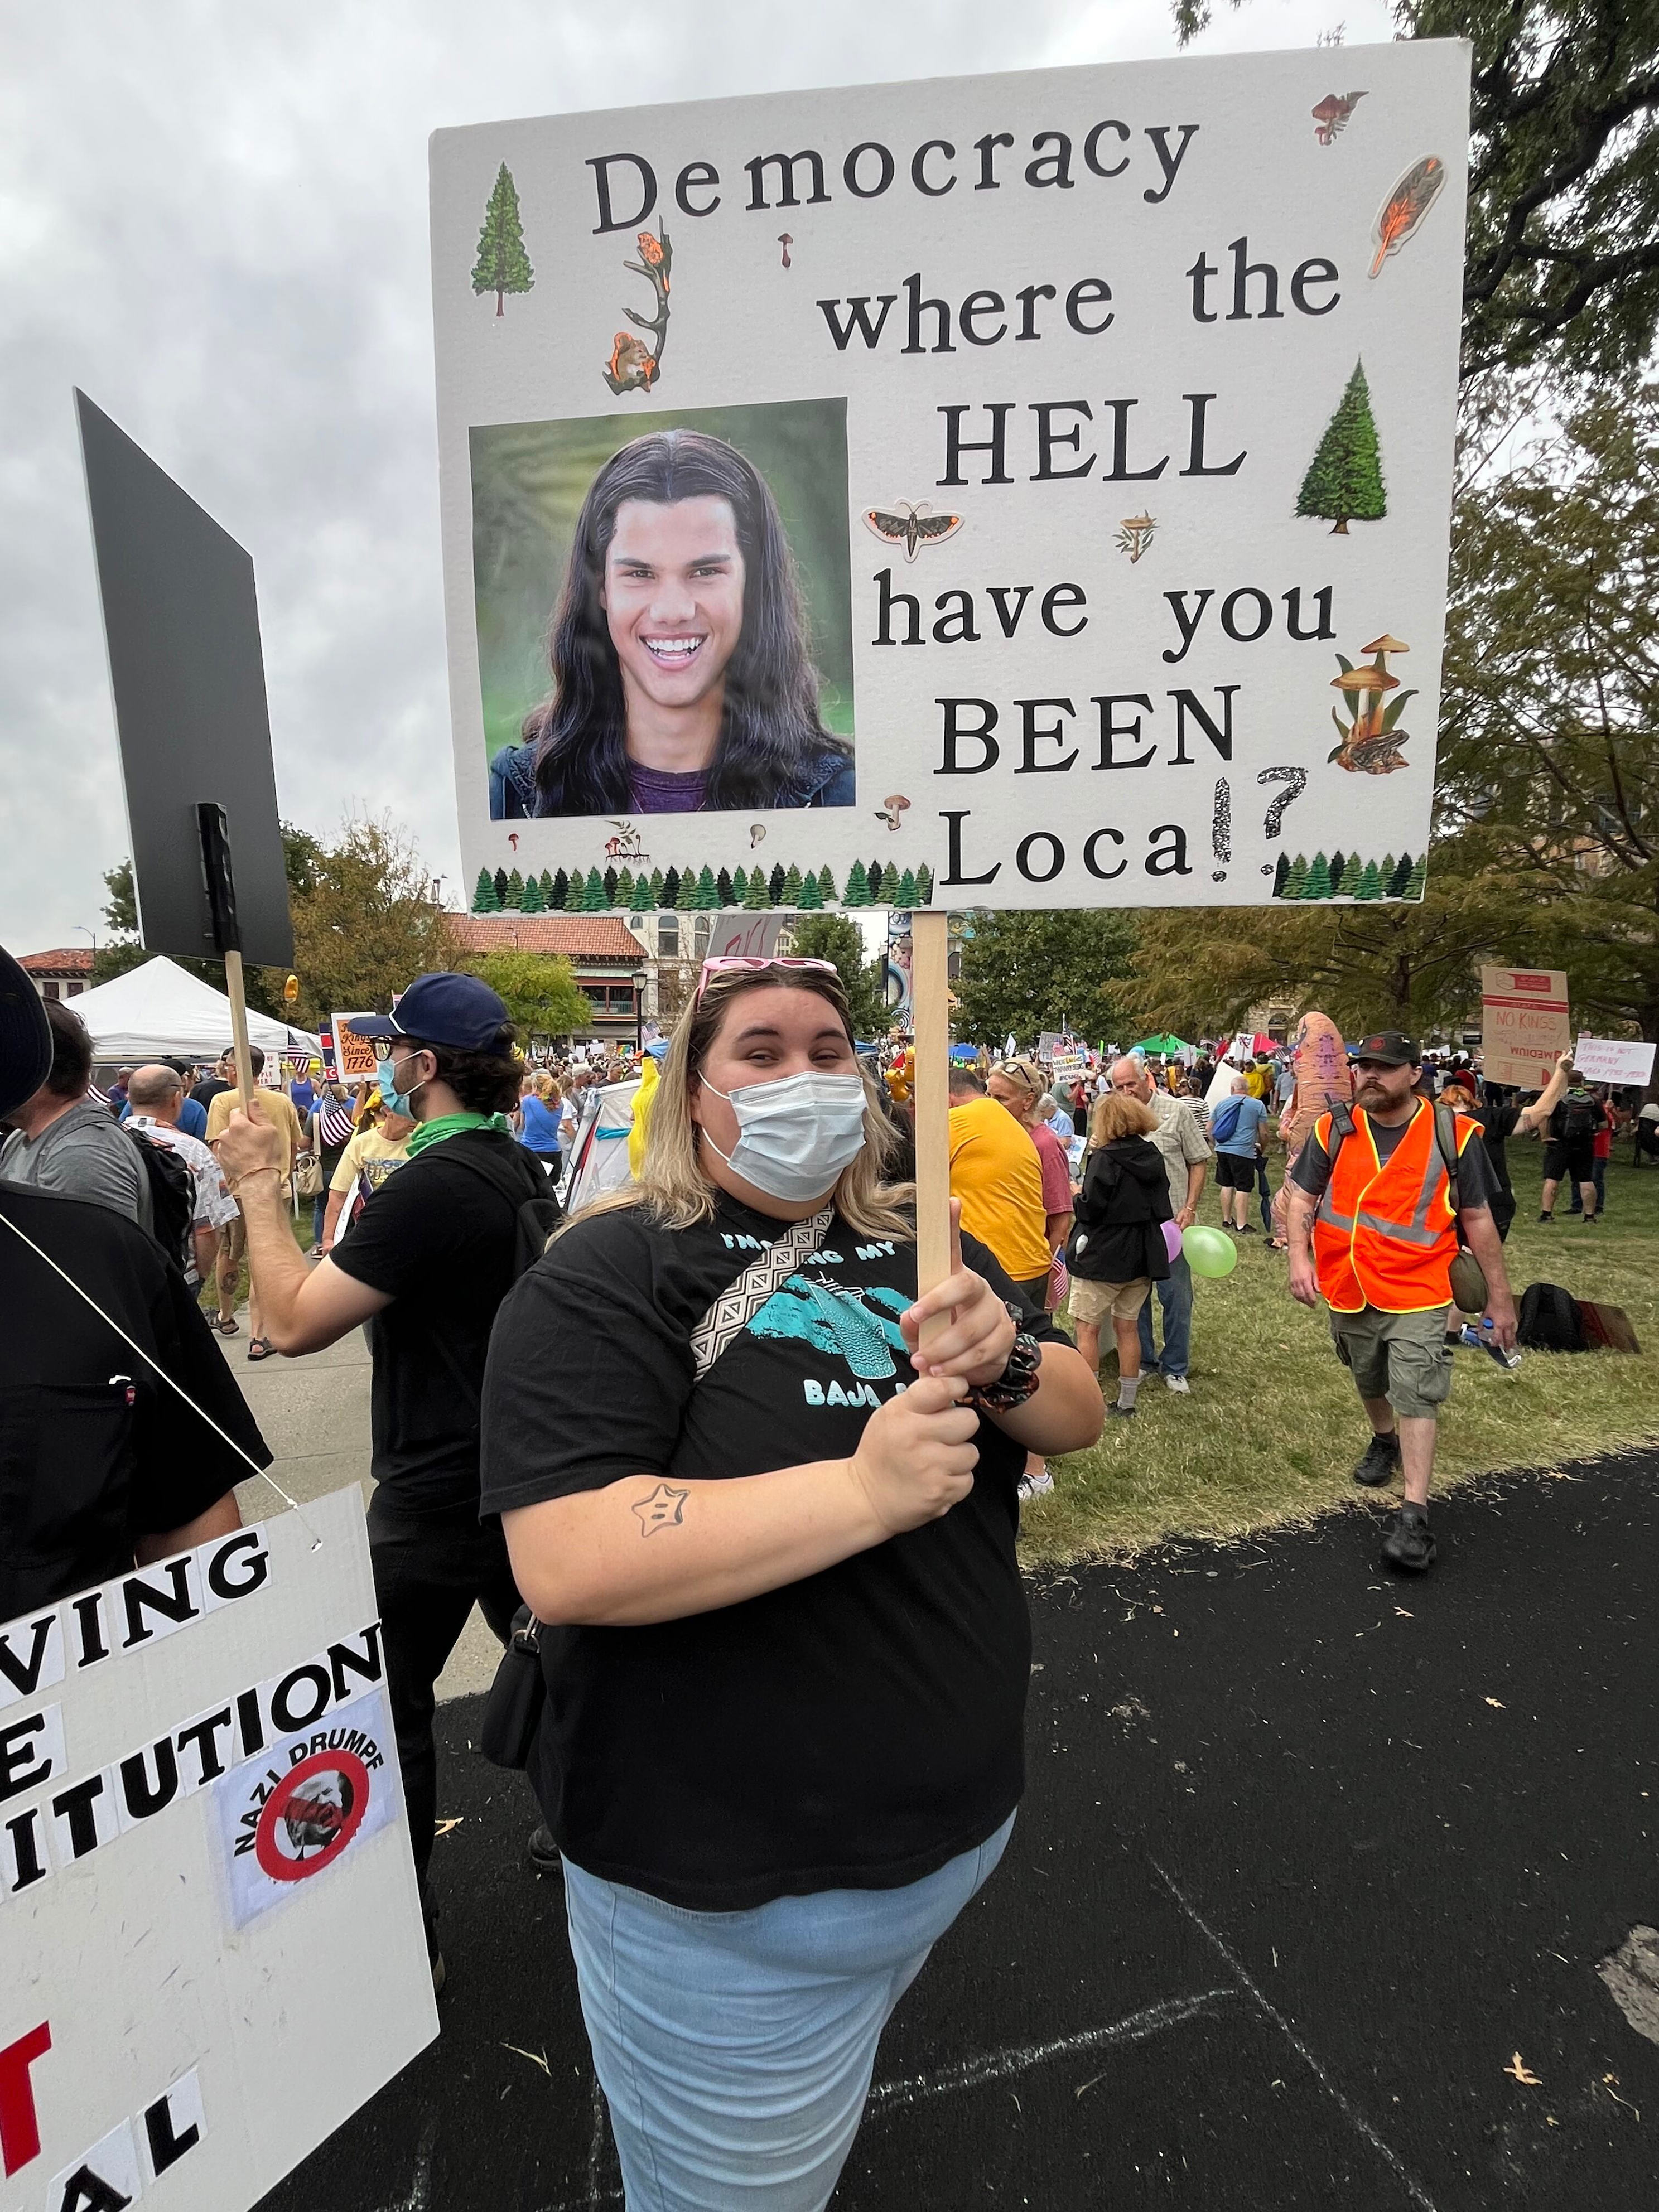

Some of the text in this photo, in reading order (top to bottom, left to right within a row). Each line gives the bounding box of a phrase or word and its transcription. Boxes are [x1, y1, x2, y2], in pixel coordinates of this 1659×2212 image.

[585, 119, 1199, 234] Democracy
[817, 237, 1341, 353] where the
[935, 393, 1248, 486] HELL
[871, 568, 1337, 663] have you
[933, 685, 1241, 775] BEEN
[343, 1045, 373, 1057] Since
[346, 1055, 373, 1070] 1776
[1496, 1011, 1557, 1031] NO KINGS
[1510, 1046, 1554, 1060] MEDIUM
[720, 1232, 763, 1251] I'M
[855, 1240, 896, 1261] MY
[234, 1728, 384, 1857] NAZI DRUMPF
